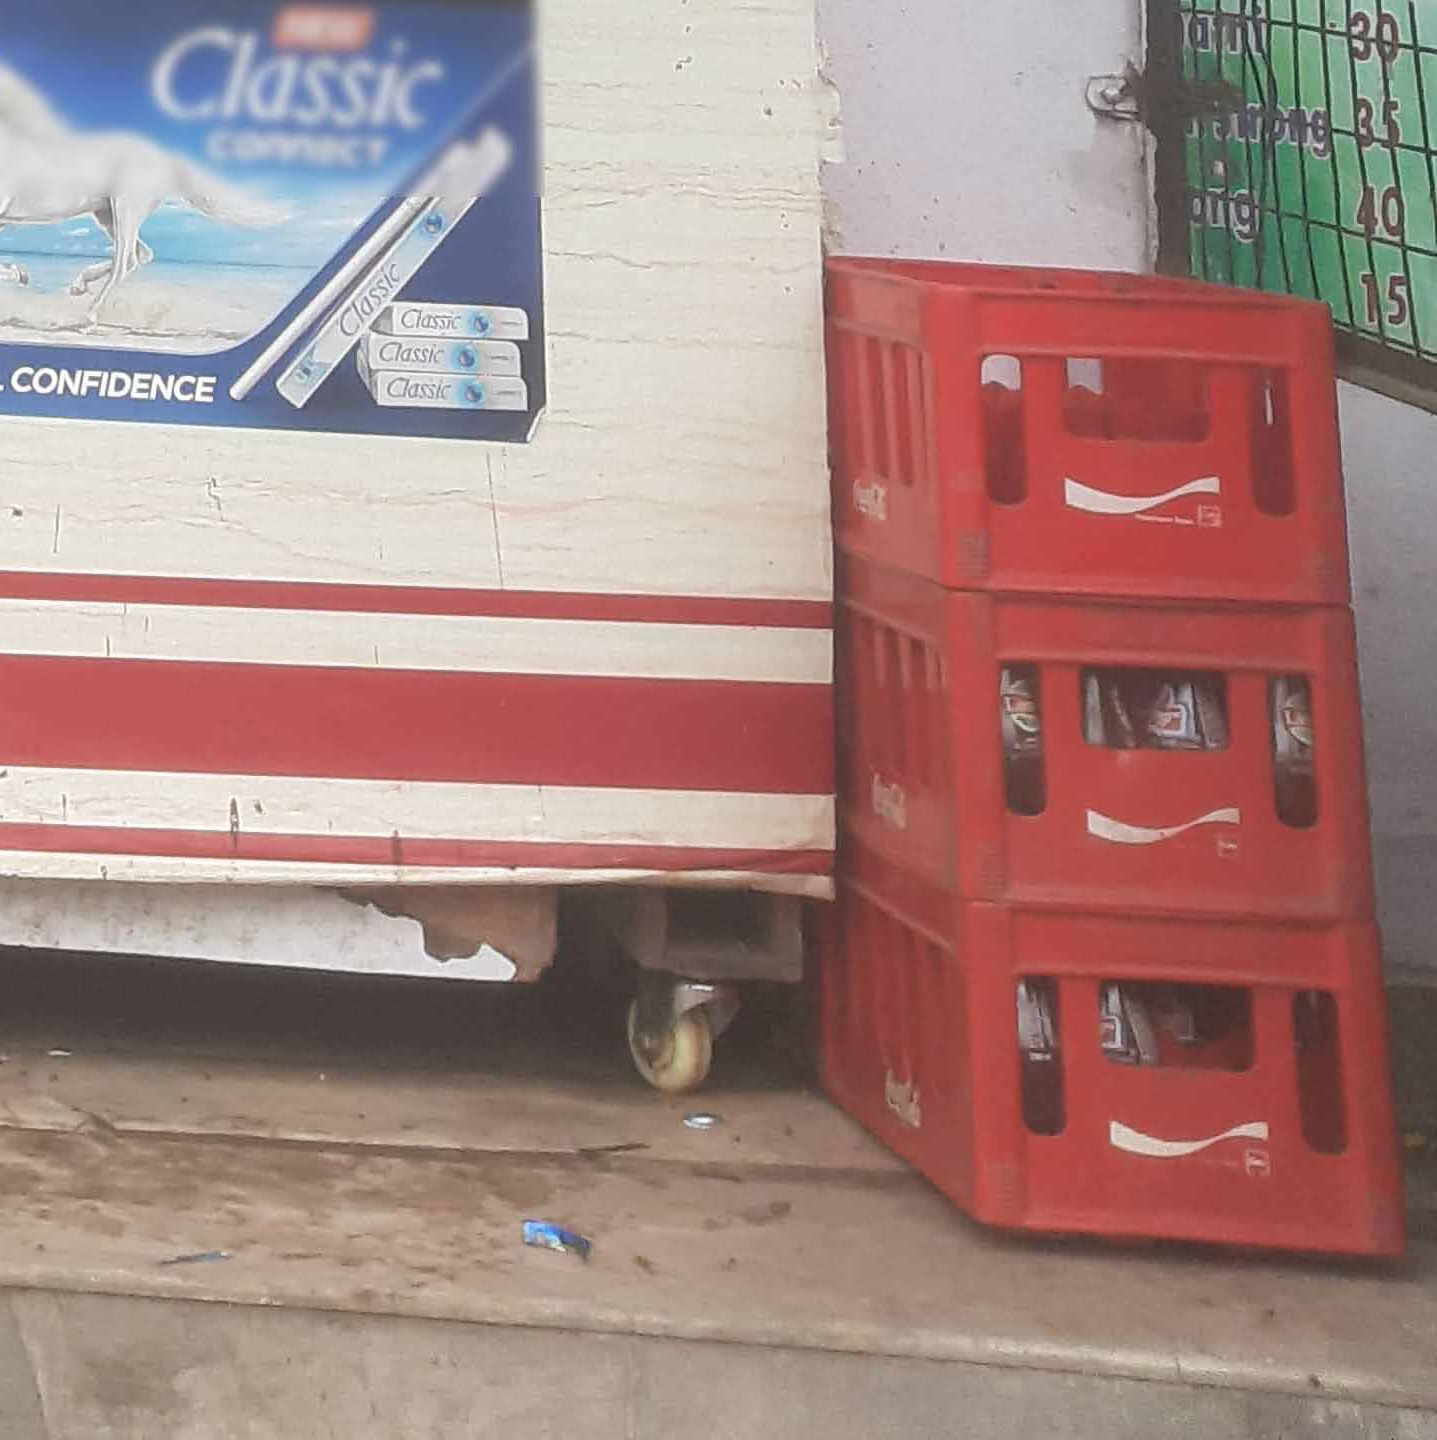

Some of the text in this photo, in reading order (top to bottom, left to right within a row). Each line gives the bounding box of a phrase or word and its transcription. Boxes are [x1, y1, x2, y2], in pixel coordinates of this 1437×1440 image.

[1349, 11, 1400, 63] 30
[151, 26, 444, 129] Classic
[1355, 97, 1401, 149] 35
[1356, 184, 1405, 238] 40
[339, 263, 400, 337] Classic
[401, 308, 462, 329] Classic
[1361, 273, 1407, 326] 15
[379, 341, 445, 364] Classic
[11, 367, 217, 403] CONFIDENCE
[386, 376, 452, 399] Classic
